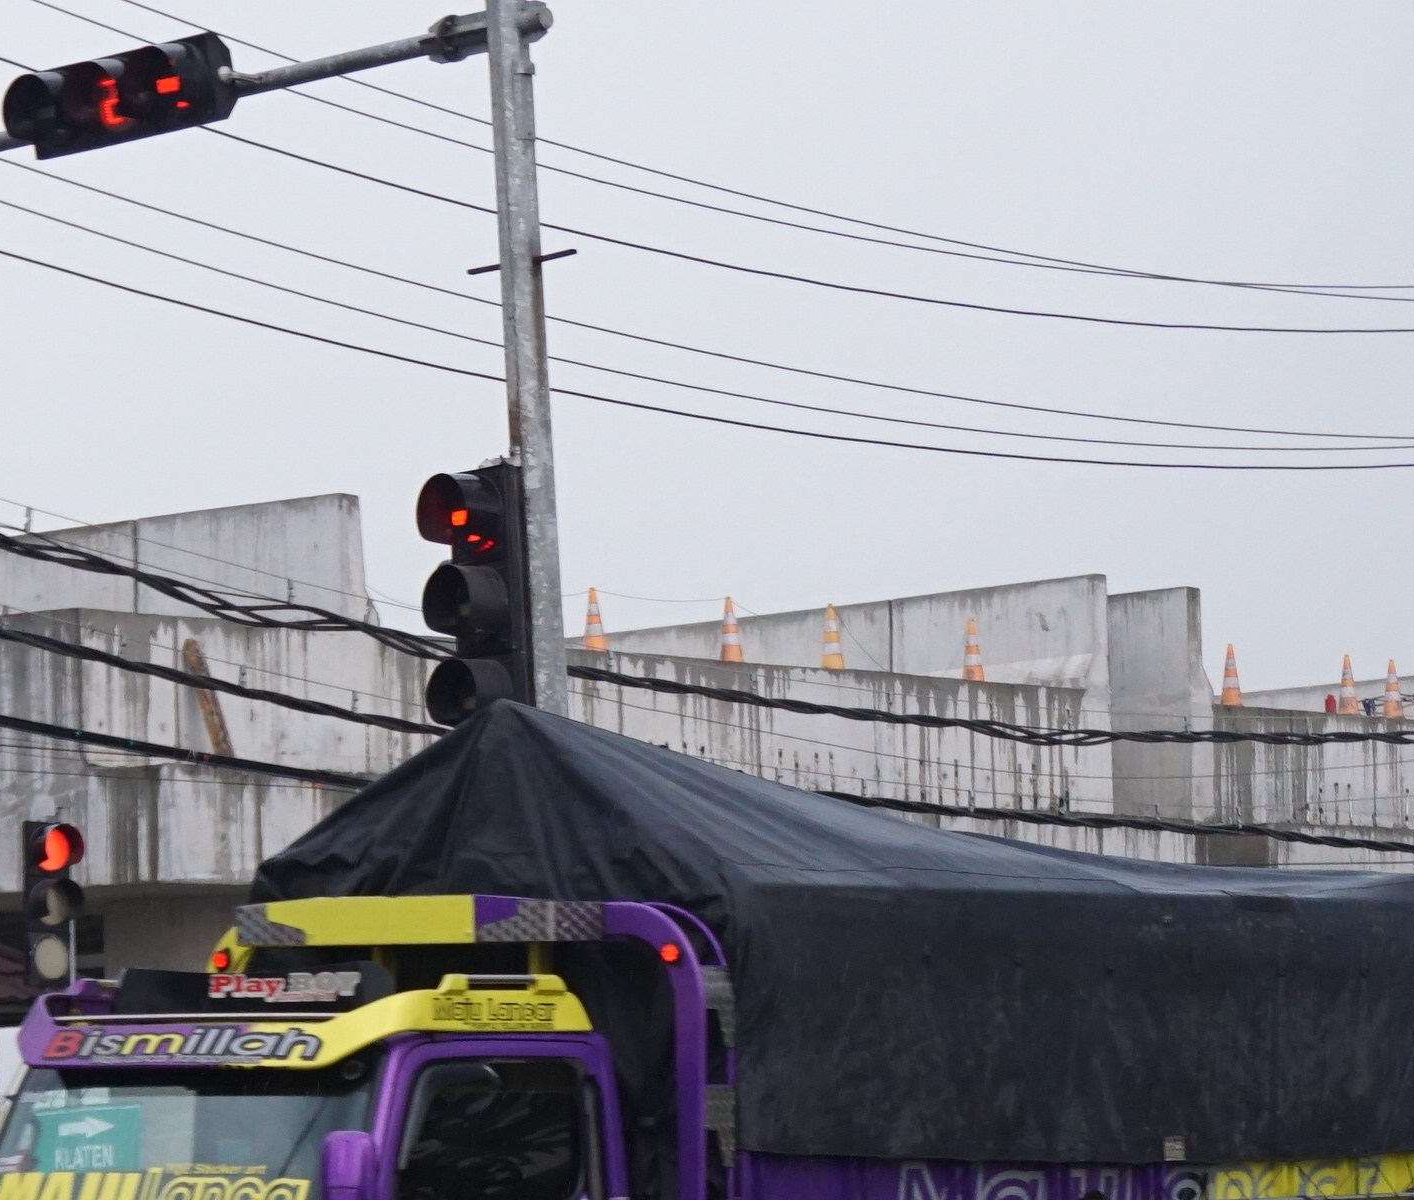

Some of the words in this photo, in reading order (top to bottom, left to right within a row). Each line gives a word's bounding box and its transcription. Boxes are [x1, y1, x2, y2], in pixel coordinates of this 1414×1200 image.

[208, 973, 285, 998] Play
[42, 1027, 323, 1063] Bismillah
[54, 1145, 114, 1170] KLATEN
